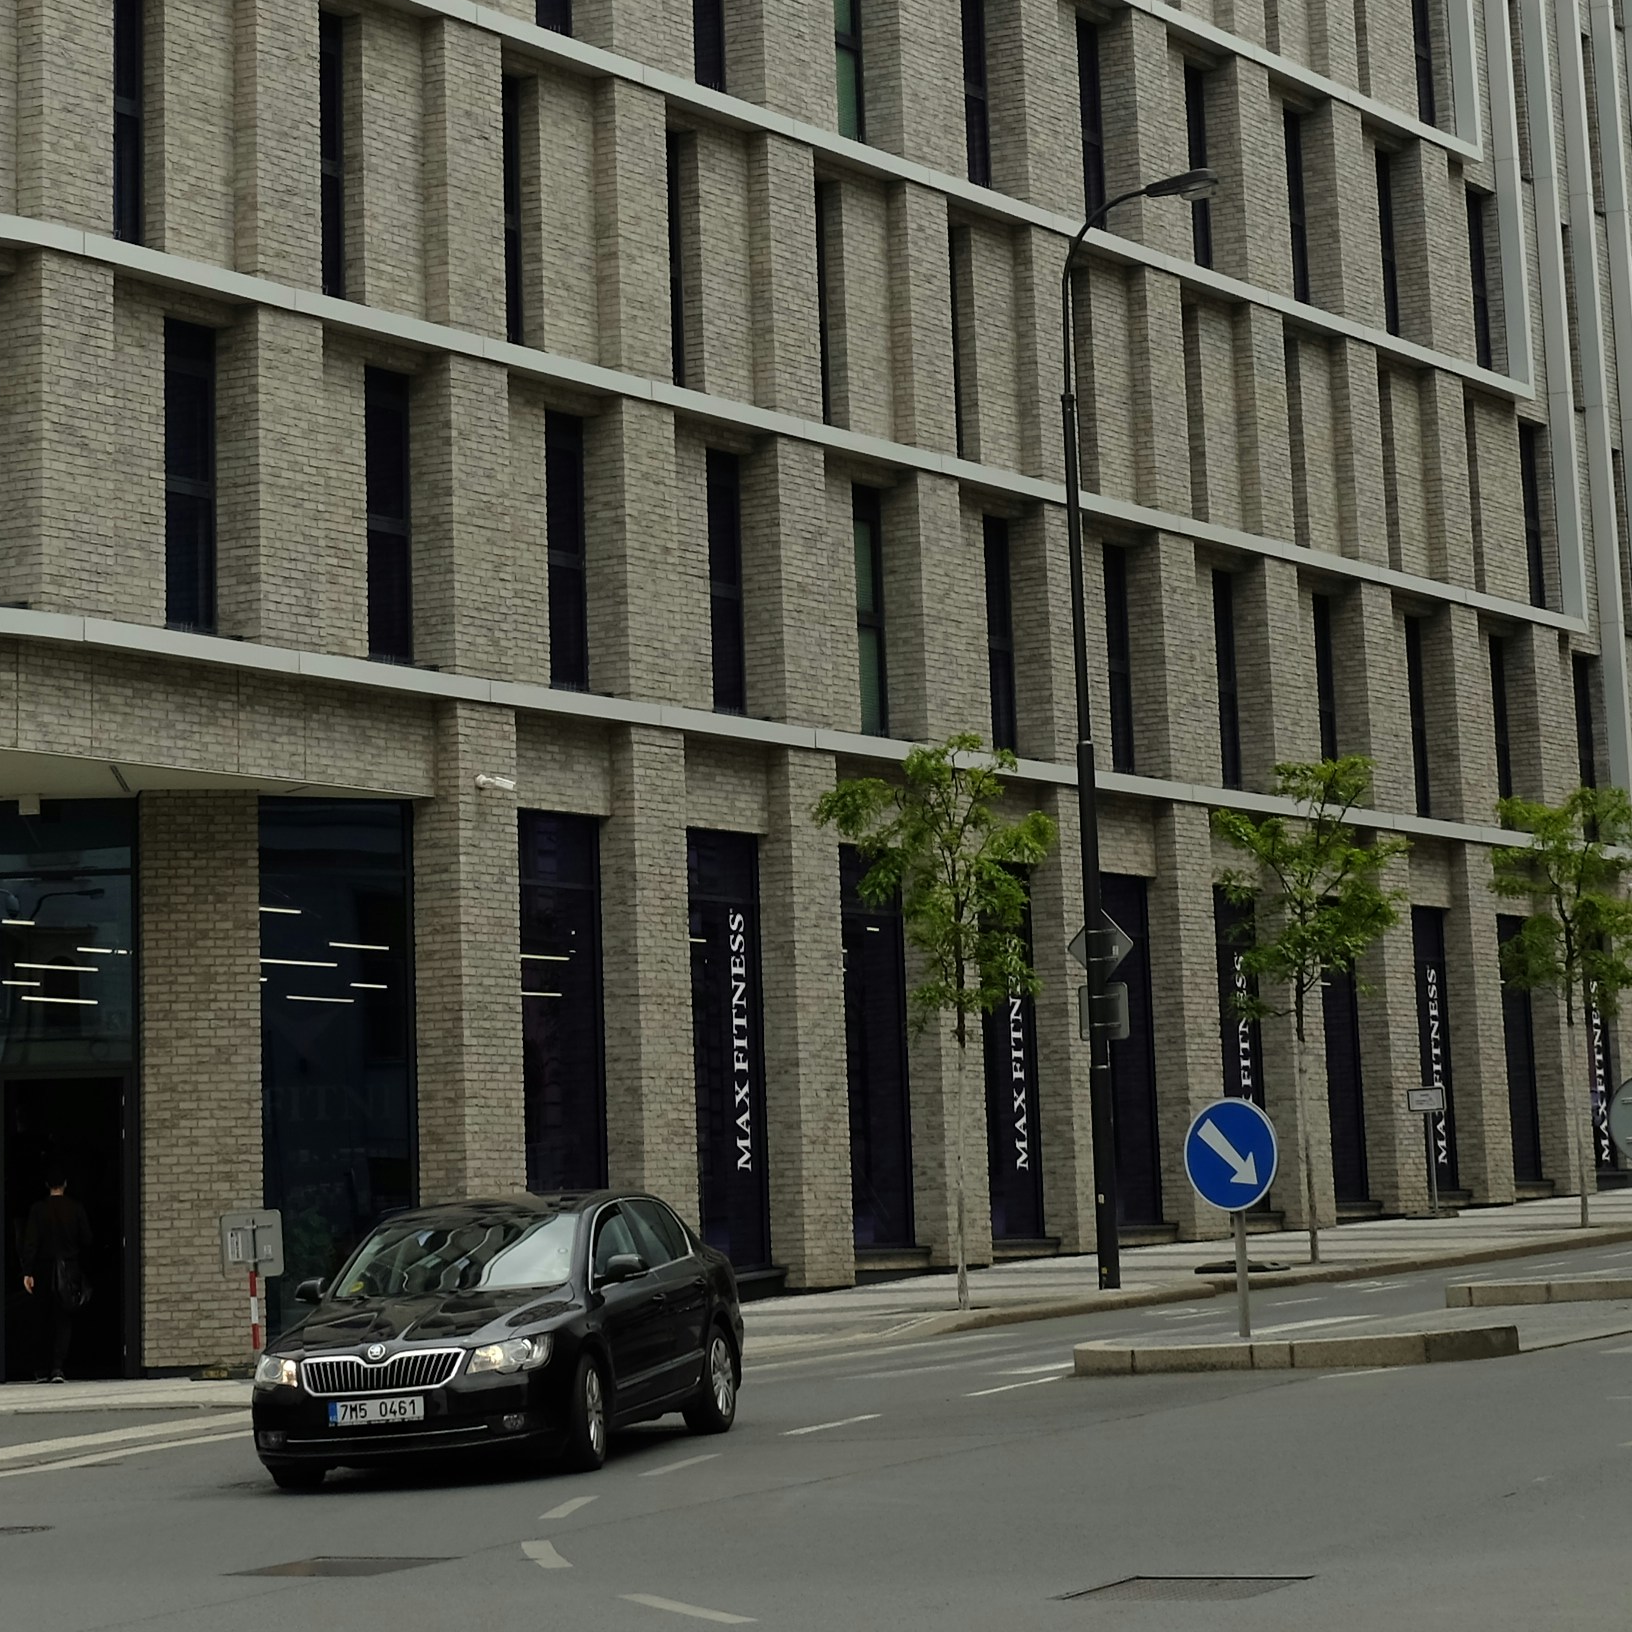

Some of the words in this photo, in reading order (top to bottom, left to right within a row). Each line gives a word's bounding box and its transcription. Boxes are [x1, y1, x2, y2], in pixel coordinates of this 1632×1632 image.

[728, 910, 750, 1073] FITNESS
[1426, 968, 1444, 1087] FITNESS
[734, 1079, 752, 1172] MAX
[1013, 1088, 1029, 1172] MAX
[1598, 1095, 1611, 1163] MAX
[340, 1402, 368, 1421] 7M5
[379, 1398, 416, 1418] 0461
